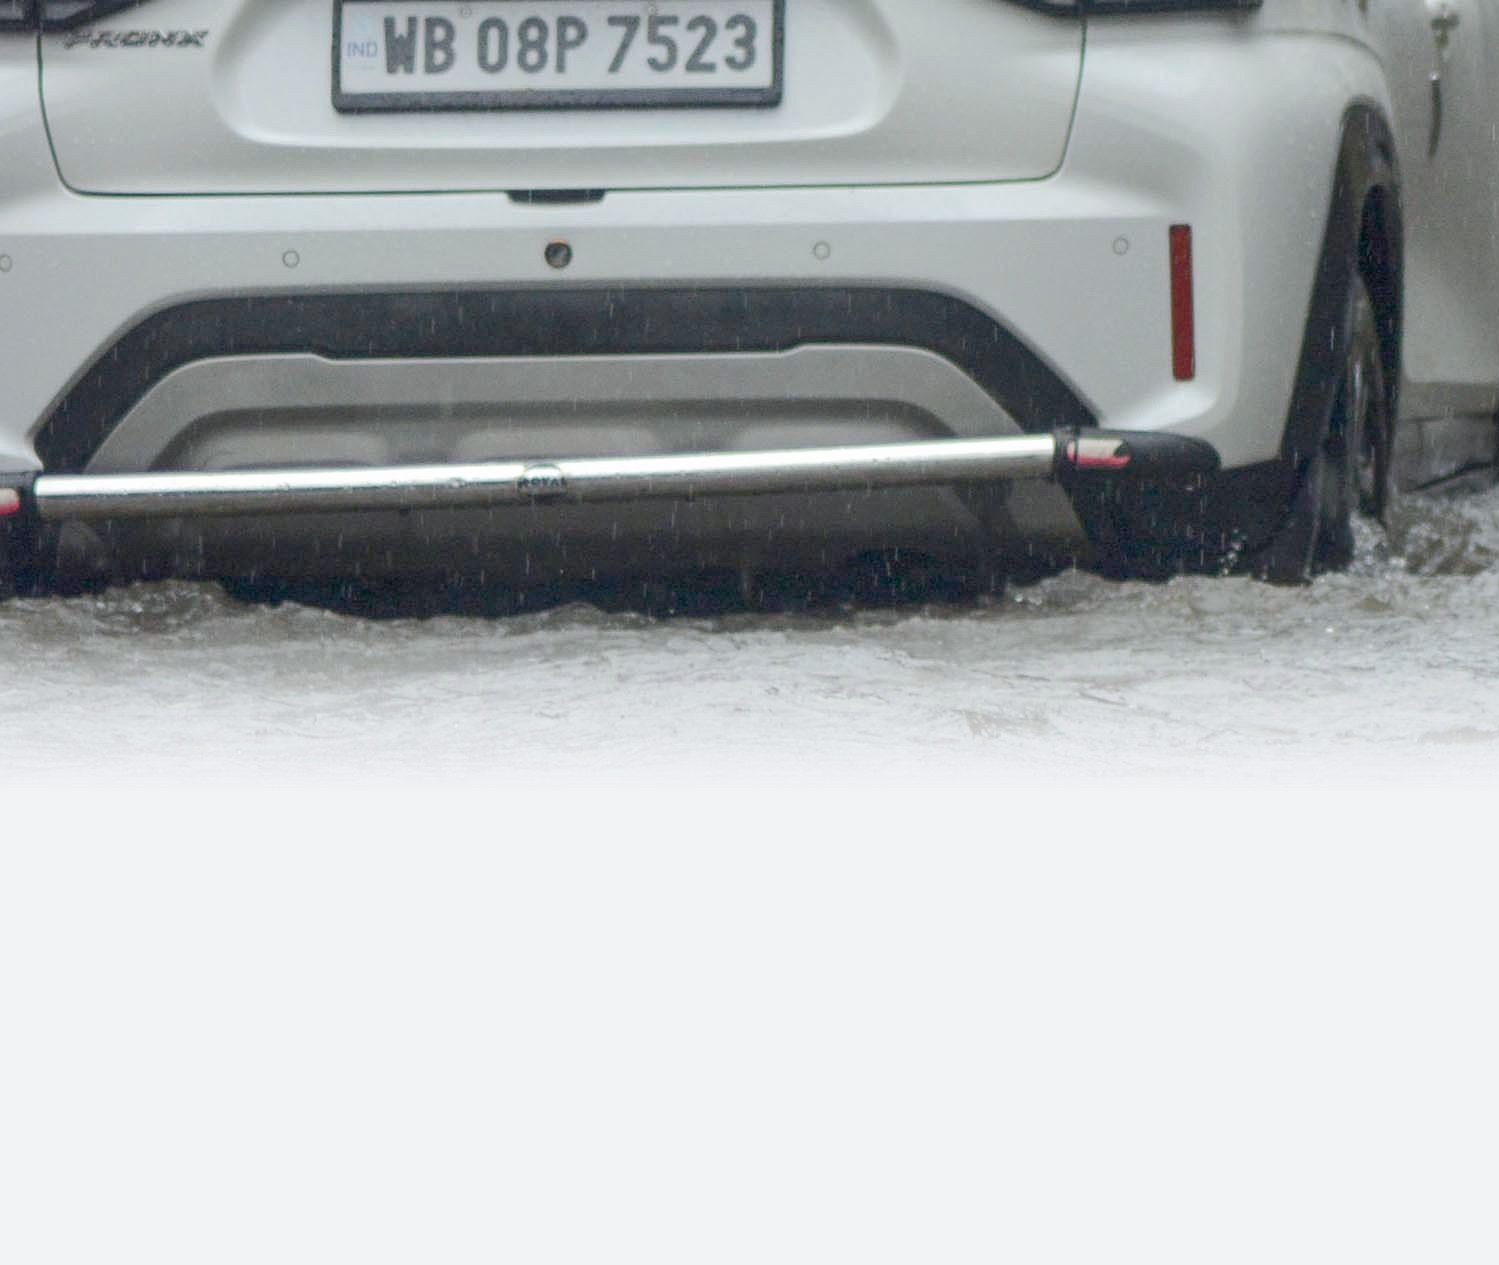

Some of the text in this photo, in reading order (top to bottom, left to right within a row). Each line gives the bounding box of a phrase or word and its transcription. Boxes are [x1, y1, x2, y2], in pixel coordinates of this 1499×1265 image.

[347, 14, 759, 76] IND WB 08P 7523
